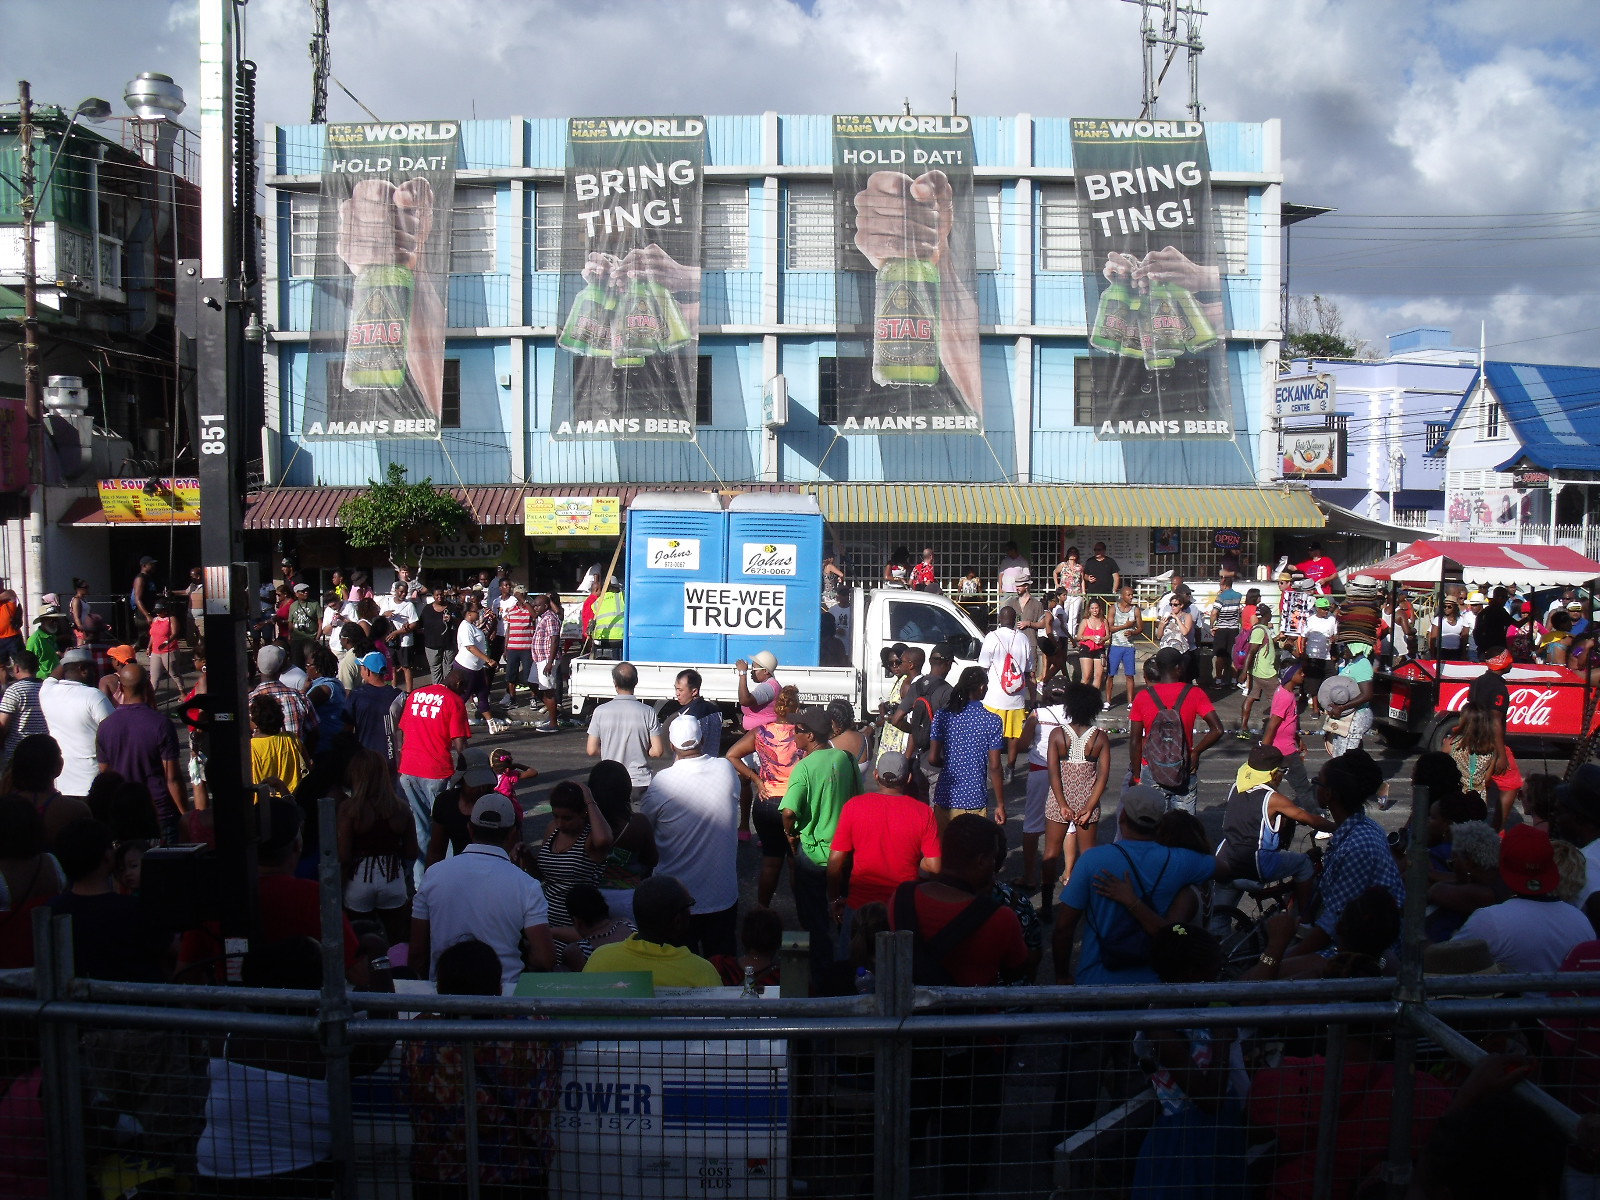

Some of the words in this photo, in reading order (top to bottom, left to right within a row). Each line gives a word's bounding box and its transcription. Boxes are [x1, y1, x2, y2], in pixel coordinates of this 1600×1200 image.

[572, 121, 595, 129] IT'S
[607, 120, 703, 137] WORLD
[837, 116, 860, 124] IT'S
[863, 116, 871, 124] A
[871, 116, 968, 133] WORLD
[363, 123, 457, 141] WORLD
[1074, 130, 1109, 138] MAN'S
[1108, 121, 1203, 138] WORLD
[332, 157, 392, 173] HOLD
[399, 156, 447, 171] DAT!
[843, 149, 906, 164] HOLD
[913, 150, 963, 164] DAT!
[575, 160, 695, 201] BRING
[1084, 161, 1202, 201] BRING
[578, 198, 682, 238] TING!
[1092, 198, 1195, 238] TING!
[350, 322, 401, 345] STAG
[877, 318, 931, 339] STAG
[1275, 382, 1329, 403] ECKANKAR
[1291, 403, 1310, 412] CENTRE
[308, 421, 324, 435] A
[327, 420, 389, 435] MAN'S
[393, 418, 436, 433] BEER
[556, 421, 573, 434] A
[576, 418, 640, 434] MAN'S
[645, 418, 691, 434] BEER
[843, 416, 860, 430] A
[863, 416, 928, 430] MAN'S
[932, 415, 979, 430] BEER
[1099, 420, 1116, 435] A
[1118, 420, 1181, 434] MAN'S
[1184, 420, 1230, 434] BEER
[200, 414, 225, 455] 851
[102, 479, 118, 490] AL
[175, 479, 200, 489] GYR
[1214, 534, 1241, 545] OPEN
[414, 543, 455, 557] CORN
[460, 543, 501, 557] SOUP
[654, 548, 692, 565] Johns
[744, 552, 793, 572] Johns
[750, 567, 792, 575] 673-0067
[686, 587, 784, 606] WEE-WEE
[686, 605, 783, 629] TRUCK
[412, 692, 444, 706] 100%
[1494, 694, 1504, 706] 3
[557, 1081, 652, 1115] OWER
[553, 1115, 652, 1130] 28-1573
